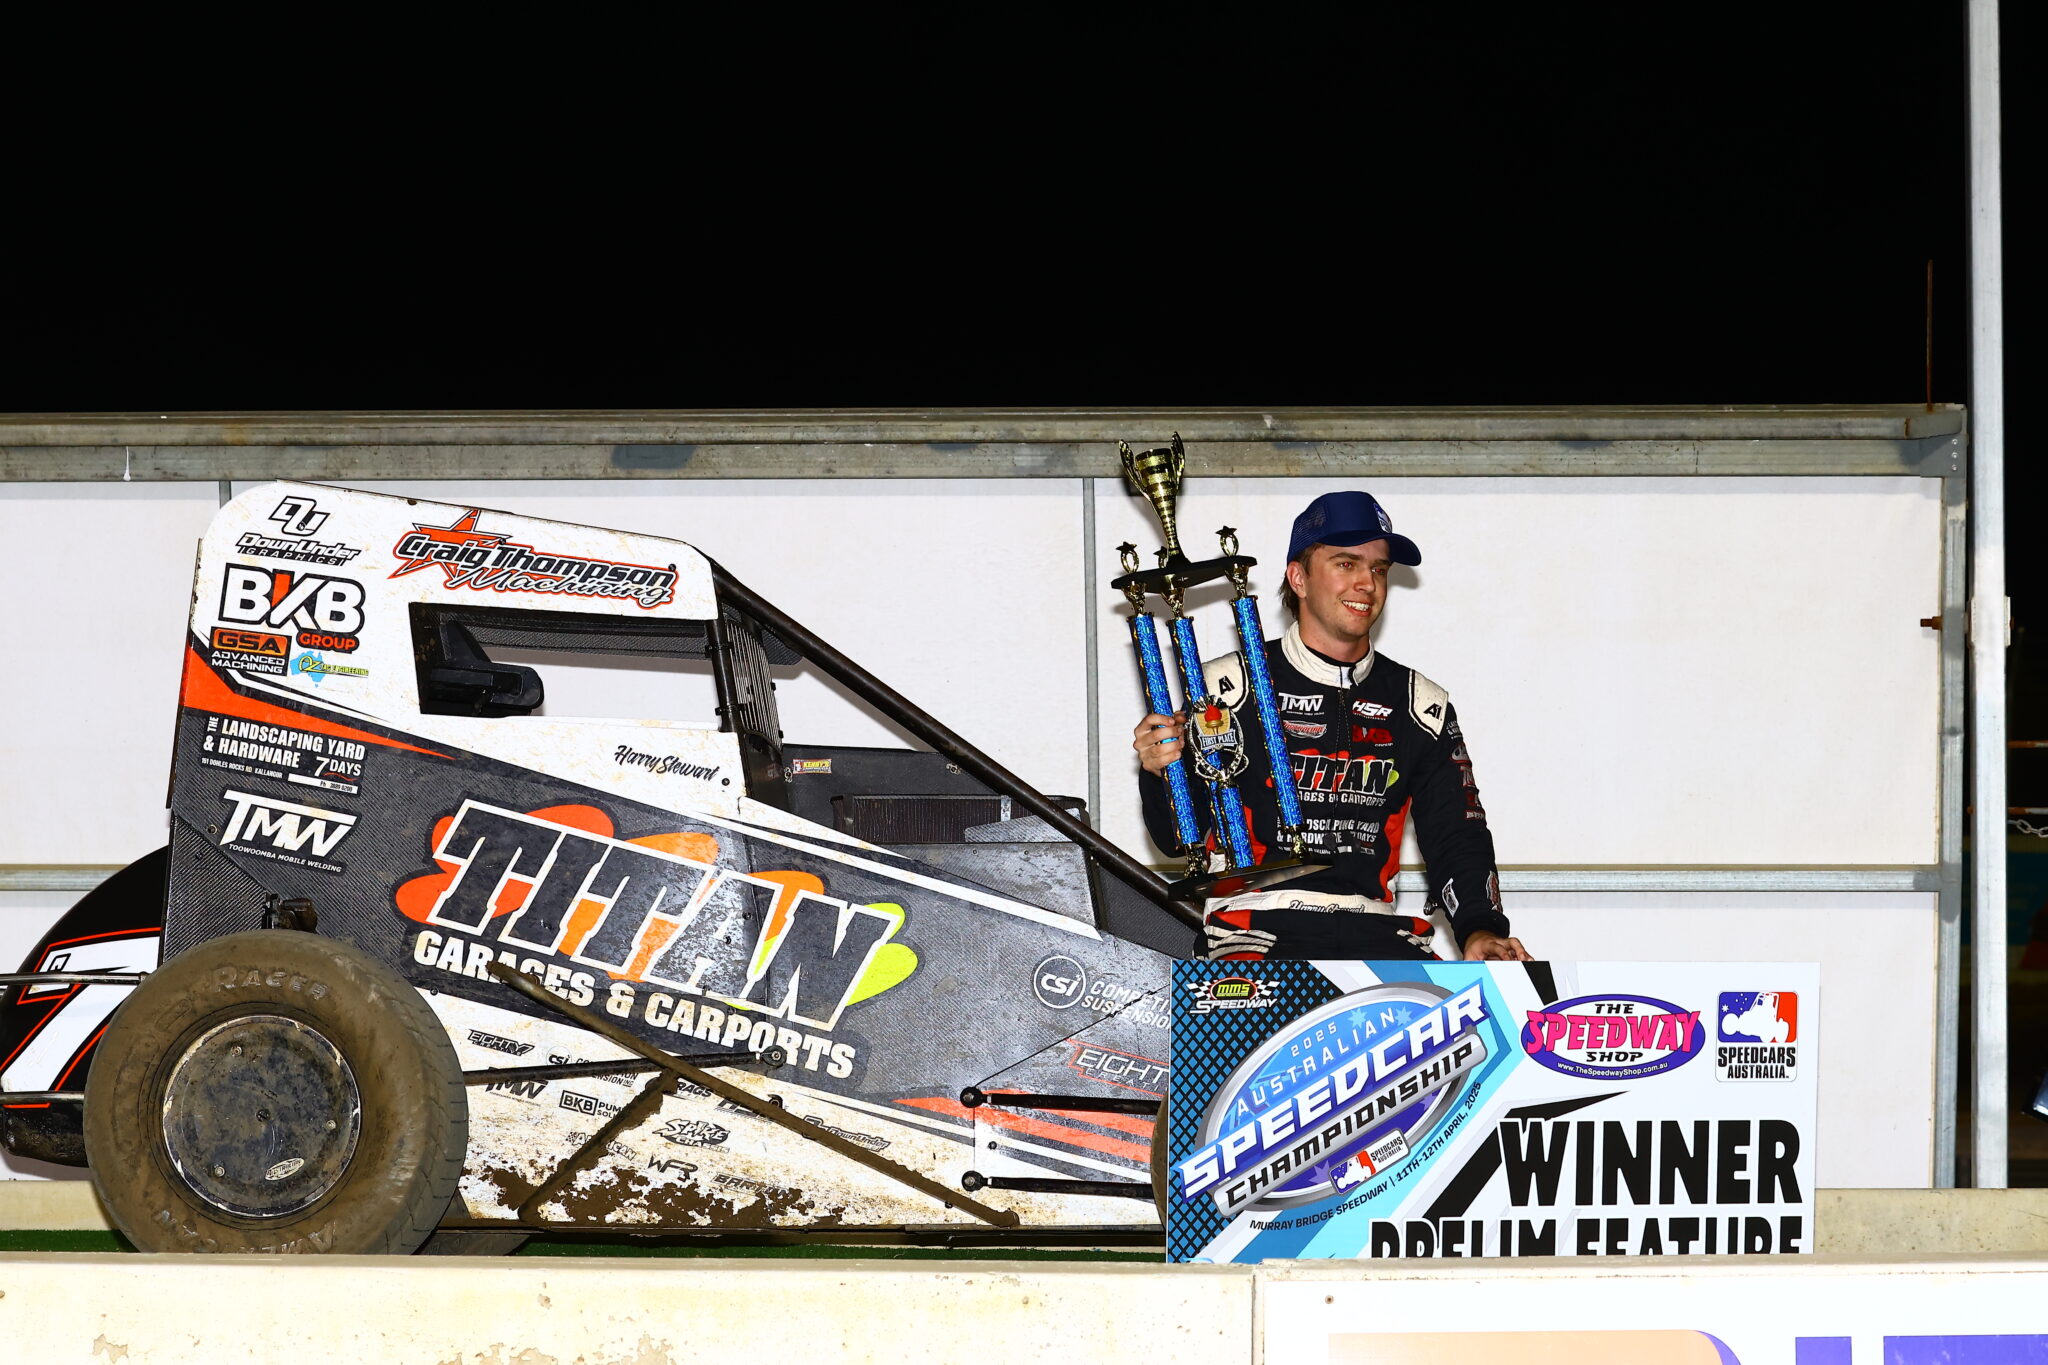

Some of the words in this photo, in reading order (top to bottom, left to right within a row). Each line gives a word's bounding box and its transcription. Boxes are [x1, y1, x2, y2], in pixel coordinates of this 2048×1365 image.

[245, 546, 338, 566] GRAPHICS
[399, 532, 492, 568] Craig
[490, 544, 677, 589] Thompson
[218, 562, 367, 635] BKB
[446, 566, 673, 608] Machining
[217, 631, 283, 653] GSA
[299, 632, 356, 652] GROUP
[211, 650, 285, 666] ADVANCED
[211, 658, 283, 675] MACHINING
[1278, 692, 1324, 712] TMW
[1351, 700, 1393, 717] HSR
[207, 716, 219, 732] THE
[202, 735, 215, 752] &
[218, 737, 301, 768] HARDWARE
[221, 718, 324, 753] LANDSCAPING
[327, 738, 366, 761] YARD
[1201, 735, 1218, 747] FIRST
[1217, 731, 1235, 744] PLACE
[228, 762, 245, 772] ROCKS
[314, 756, 330, 777] 7
[329, 760, 362, 777] DAYS
[614, 744, 660, 774] Harry
[656, 755, 720, 782] Stewart
[219, 789, 358, 857] TMW
[228, 843, 276, 859] TOOWOOMBA
[277, 853, 306, 866] MOBILE
[307, 859, 342, 873] WELDING
[426, 797, 896, 1032] TITAN
[1090, 980, 1171, 1016] COMPETI
[1189, 998, 1278, 1014] SPEEDWAY
[1594, 1003, 1635, 1014] THE
[605, 982, 636, 1019] &
[644, 991, 857, 1080] CARPORTS
[1289, 1021, 1338, 1057] 2025
[1526, 1009, 1701, 1054] SPEEDWAY
[1076, 1048, 1169, 1084] EIGHT
[1237, 1007, 1397, 1117] AUSTRALIAN
[1557, 1061, 1668, 1078] www.TheSpeedwayShop.com.au
[1585, 1050, 1644, 1063] SHOP
[1717, 1046, 1797, 1067] SPEEDCARS
[1085, 1068, 1169, 1092] CREATI
[1178, 983, 1490, 1201] SPEEDCAR
[562, 1094, 594, 1112] BKB
[1225, 1040, 1474, 1210] CHAMPIONSHIP
[1249, 1219, 1294, 1231] MURRAY
[1295, 1208, 1334, 1227] BRIDGE
[1335, 1180, 1389, 1216] SPEEDWAY
[1443, 1111, 1469, 1140] APRIL,
[1464, 1081, 1482, 1110] 2025
[1370, 1136, 1404, 1162] SPEEDCARS
[1377, 1145, 1402, 1164] AUSTRALIA
[1499, 1118, 1804, 1207] WINNER
